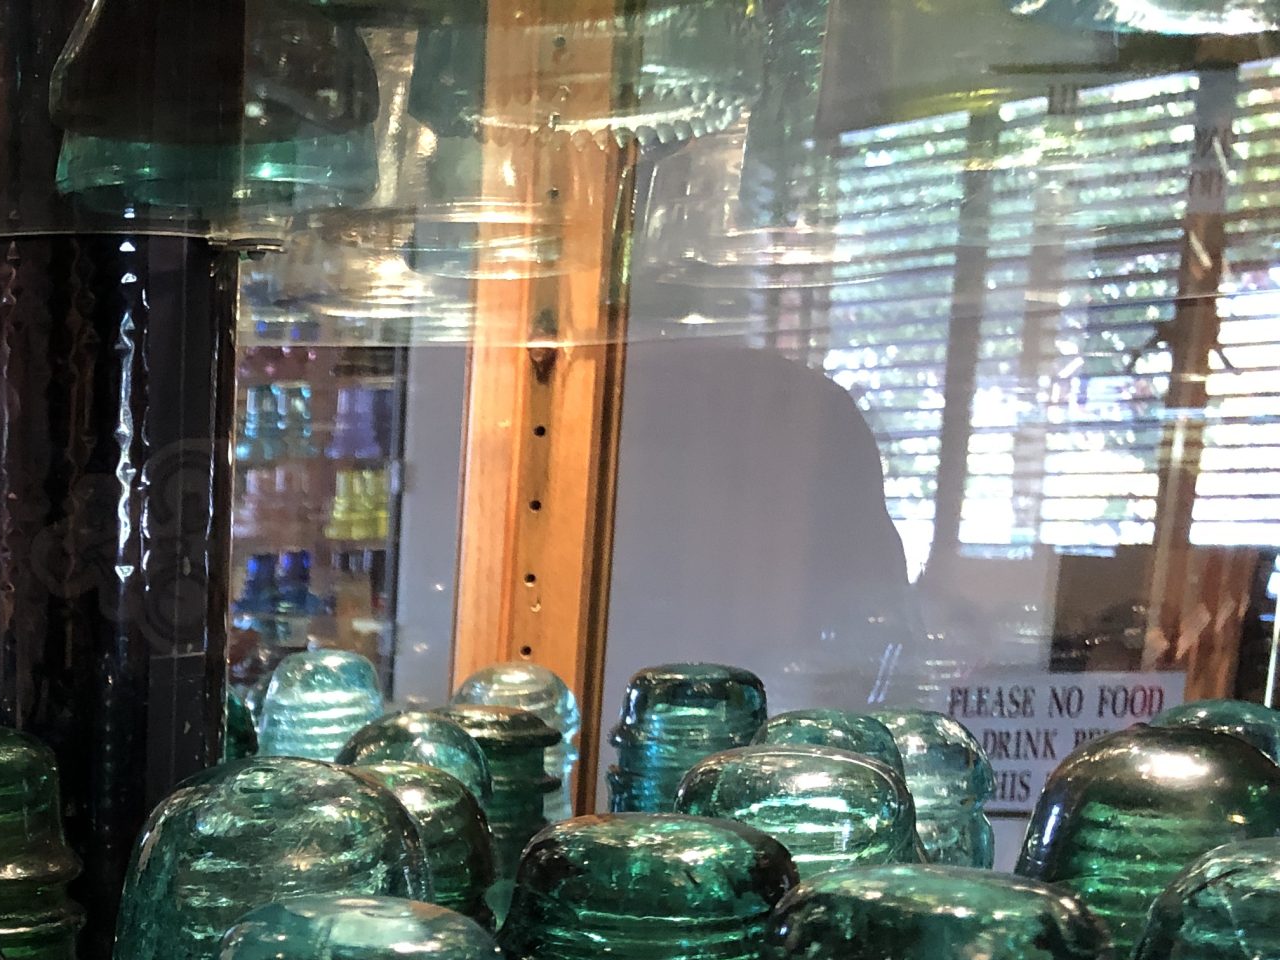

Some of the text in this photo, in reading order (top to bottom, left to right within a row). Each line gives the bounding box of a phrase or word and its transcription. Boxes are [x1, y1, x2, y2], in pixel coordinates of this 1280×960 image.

[948, 684, 1165, 719] PLEASE NO FOOD
[982, 728, 1058, 760] DRINK
[994, 768, 1032, 801] HIS
